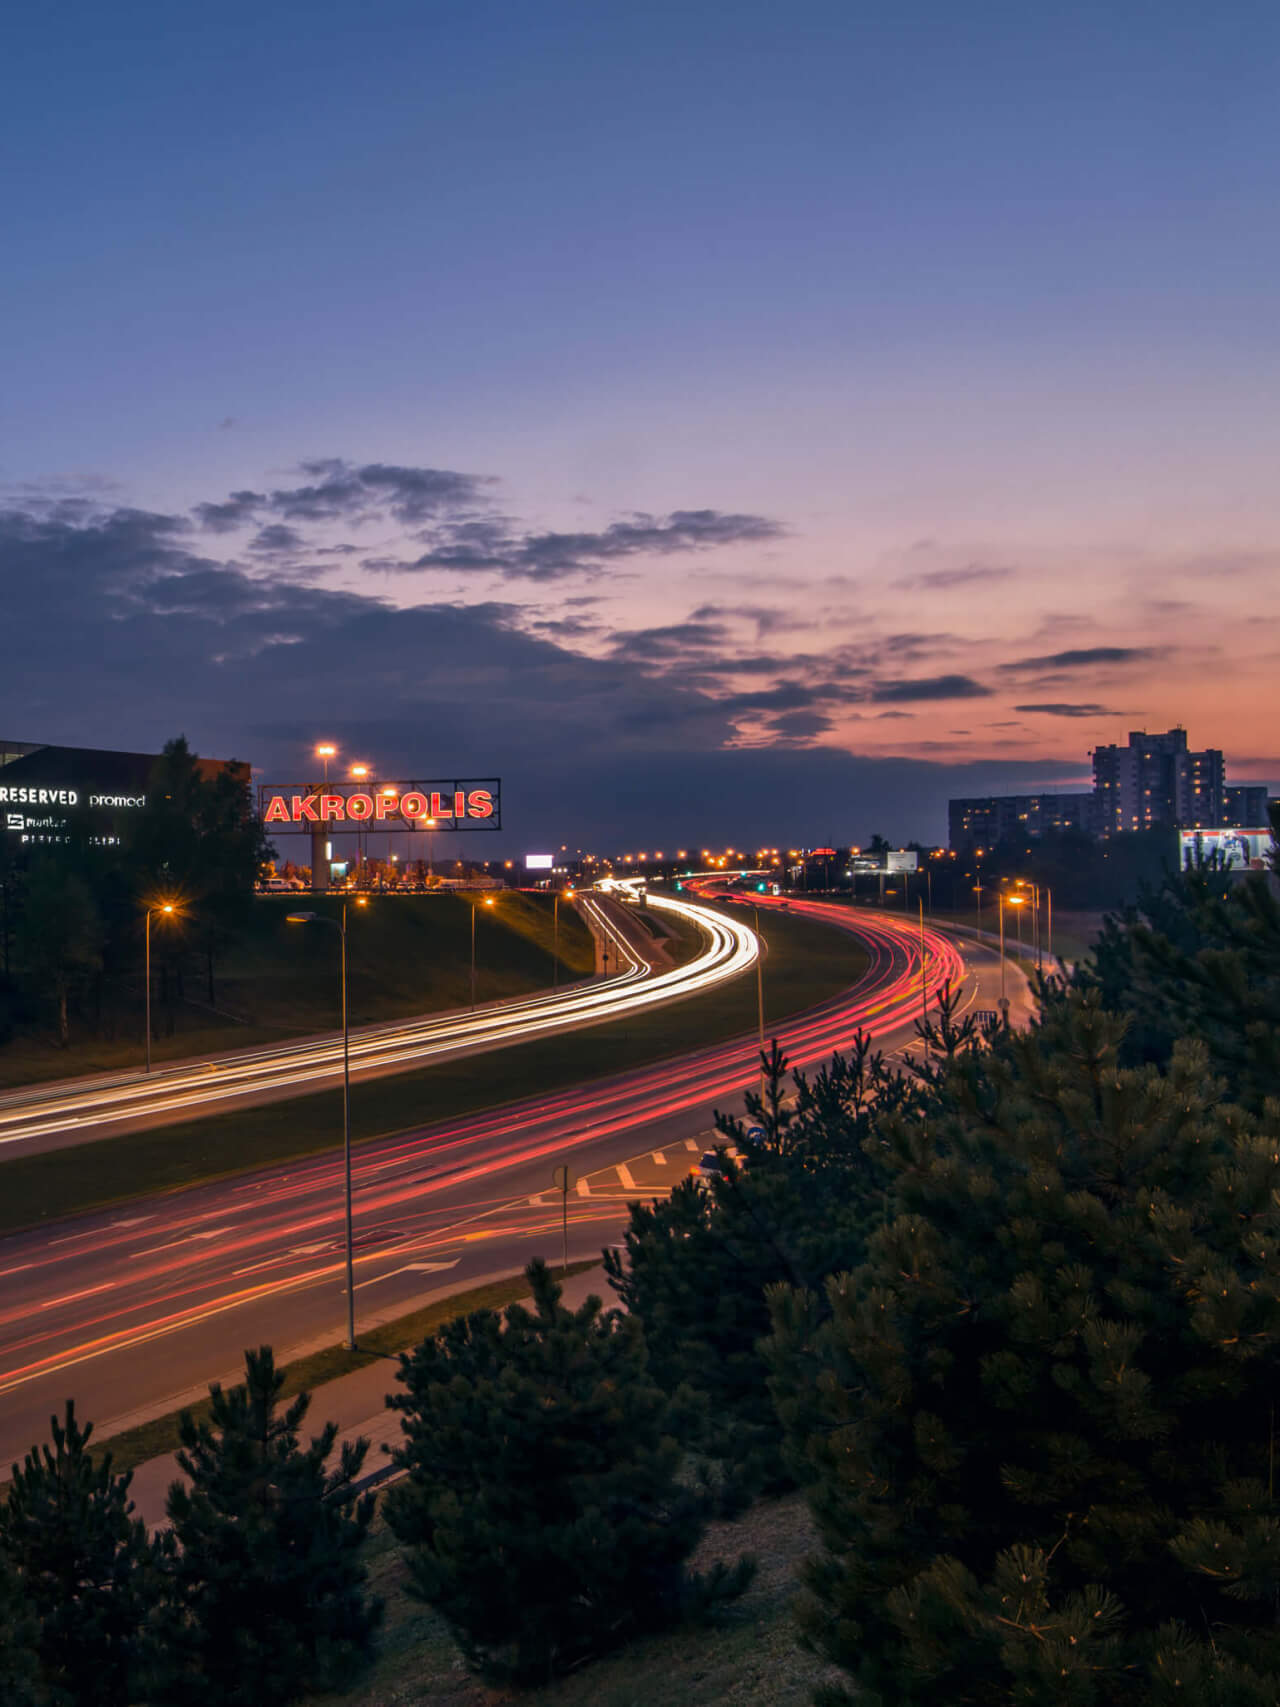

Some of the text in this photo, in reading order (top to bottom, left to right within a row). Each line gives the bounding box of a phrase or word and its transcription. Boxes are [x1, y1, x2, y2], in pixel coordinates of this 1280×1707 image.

[0, 786, 78, 806] RESERVED
[89, 794, 146, 808] promod
[264, 790, 494, 822] AKROPOLIS
